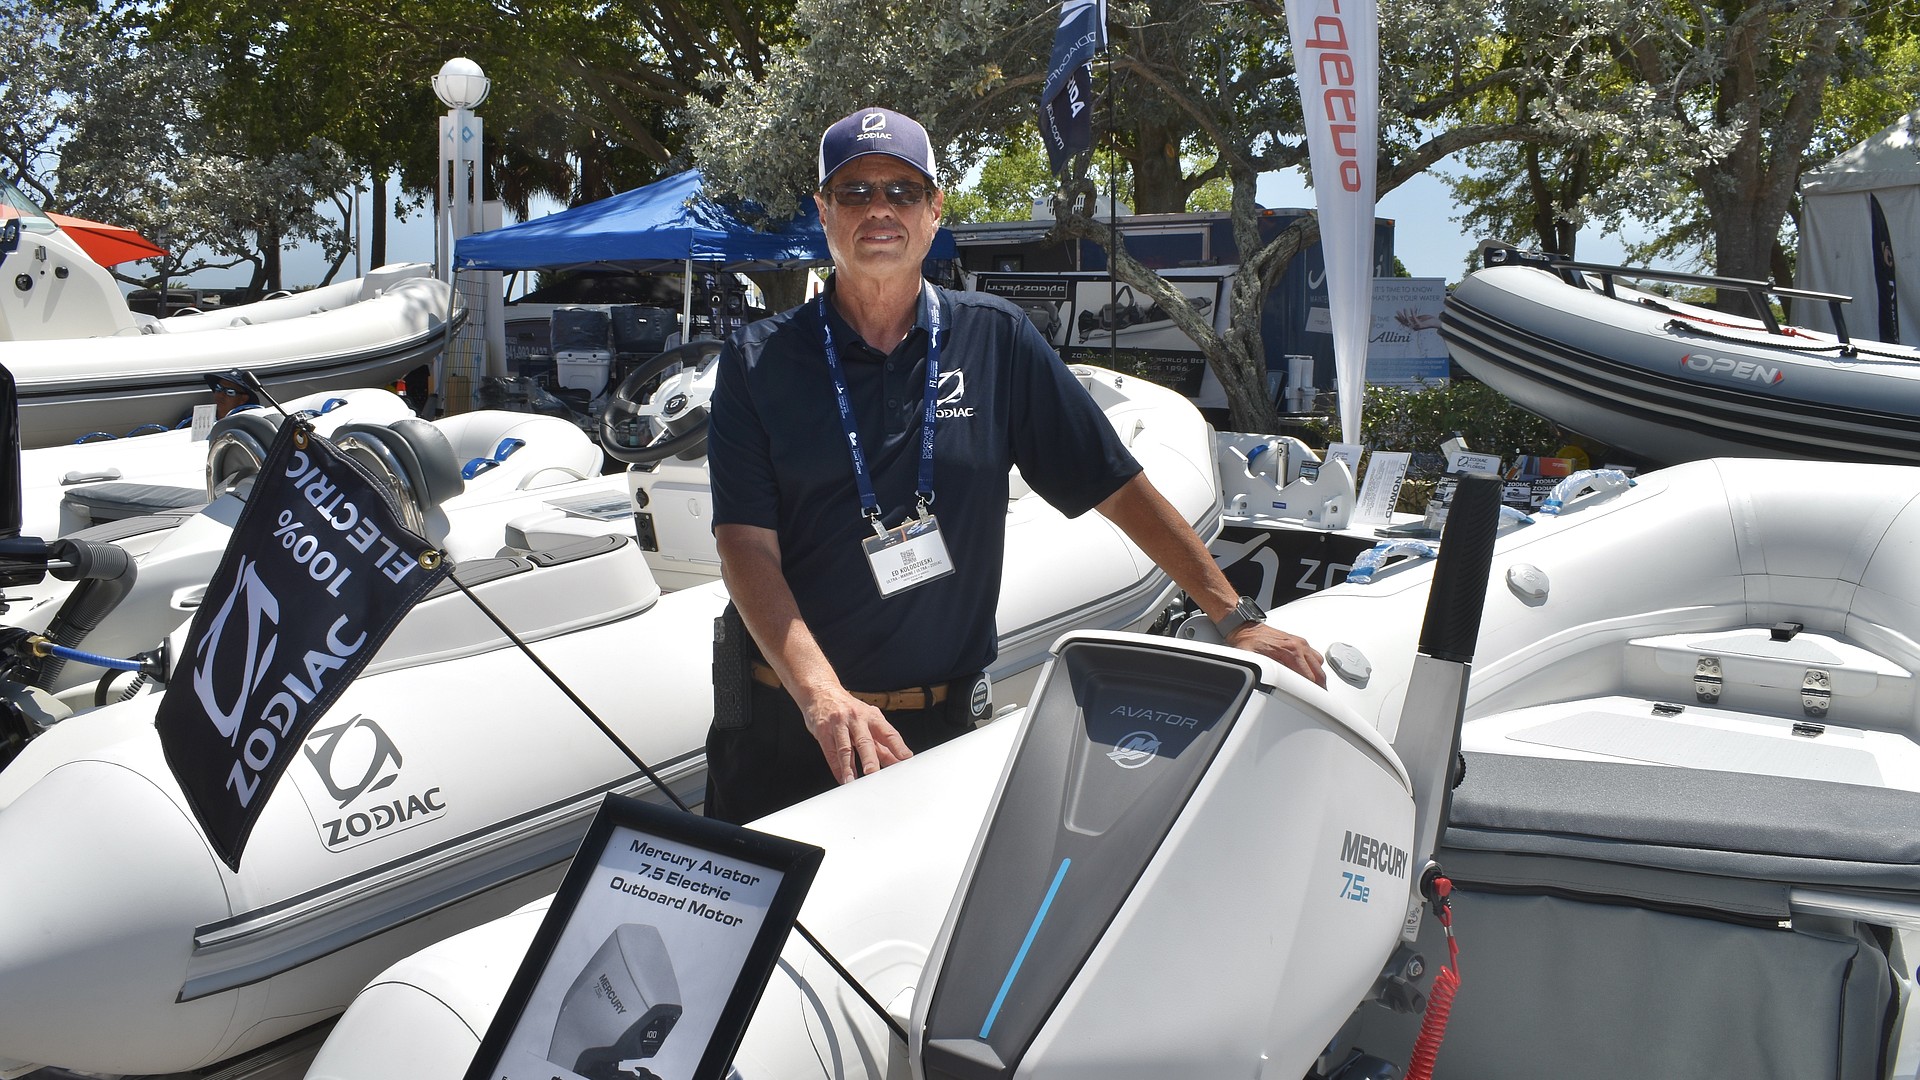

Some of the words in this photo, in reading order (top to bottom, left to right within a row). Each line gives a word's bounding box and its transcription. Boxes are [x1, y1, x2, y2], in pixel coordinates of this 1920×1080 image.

[857, 132, 892, 141] ZODIAC
[987, 284, 1065, 296] ULTRA-ZODIAC
[1688, 354, 1778, 384] OPEN
[935, 407, 974, 418] ODIAC
[922, 426, 930, 459] DISCOVER
[285, 450, 418, 584] ELECTRIC
[1385, 476, 1402, 519] NOMAD
[273, 509, 351, 599] 100%
[226, 614, 368, 808] ZODIAC
[1110, 705, 1199, 730] AVATOR
[322, 786, 446, 848] ZODIAC
[629, 839, 698, 872] Mercury
[698, 860, 760, 887] Avator
[1340, 830, 1408, 879] MERCURY
[610, 876, 687, 910] Outboard
[687, 900, 743, 928] Motor
[638, 862, 666, 881] 7.5
[666, 871, 731, 901] Electric
[599, 973, 627, 1015] MERCURY
[646, 1030, 658, 1039] 100
